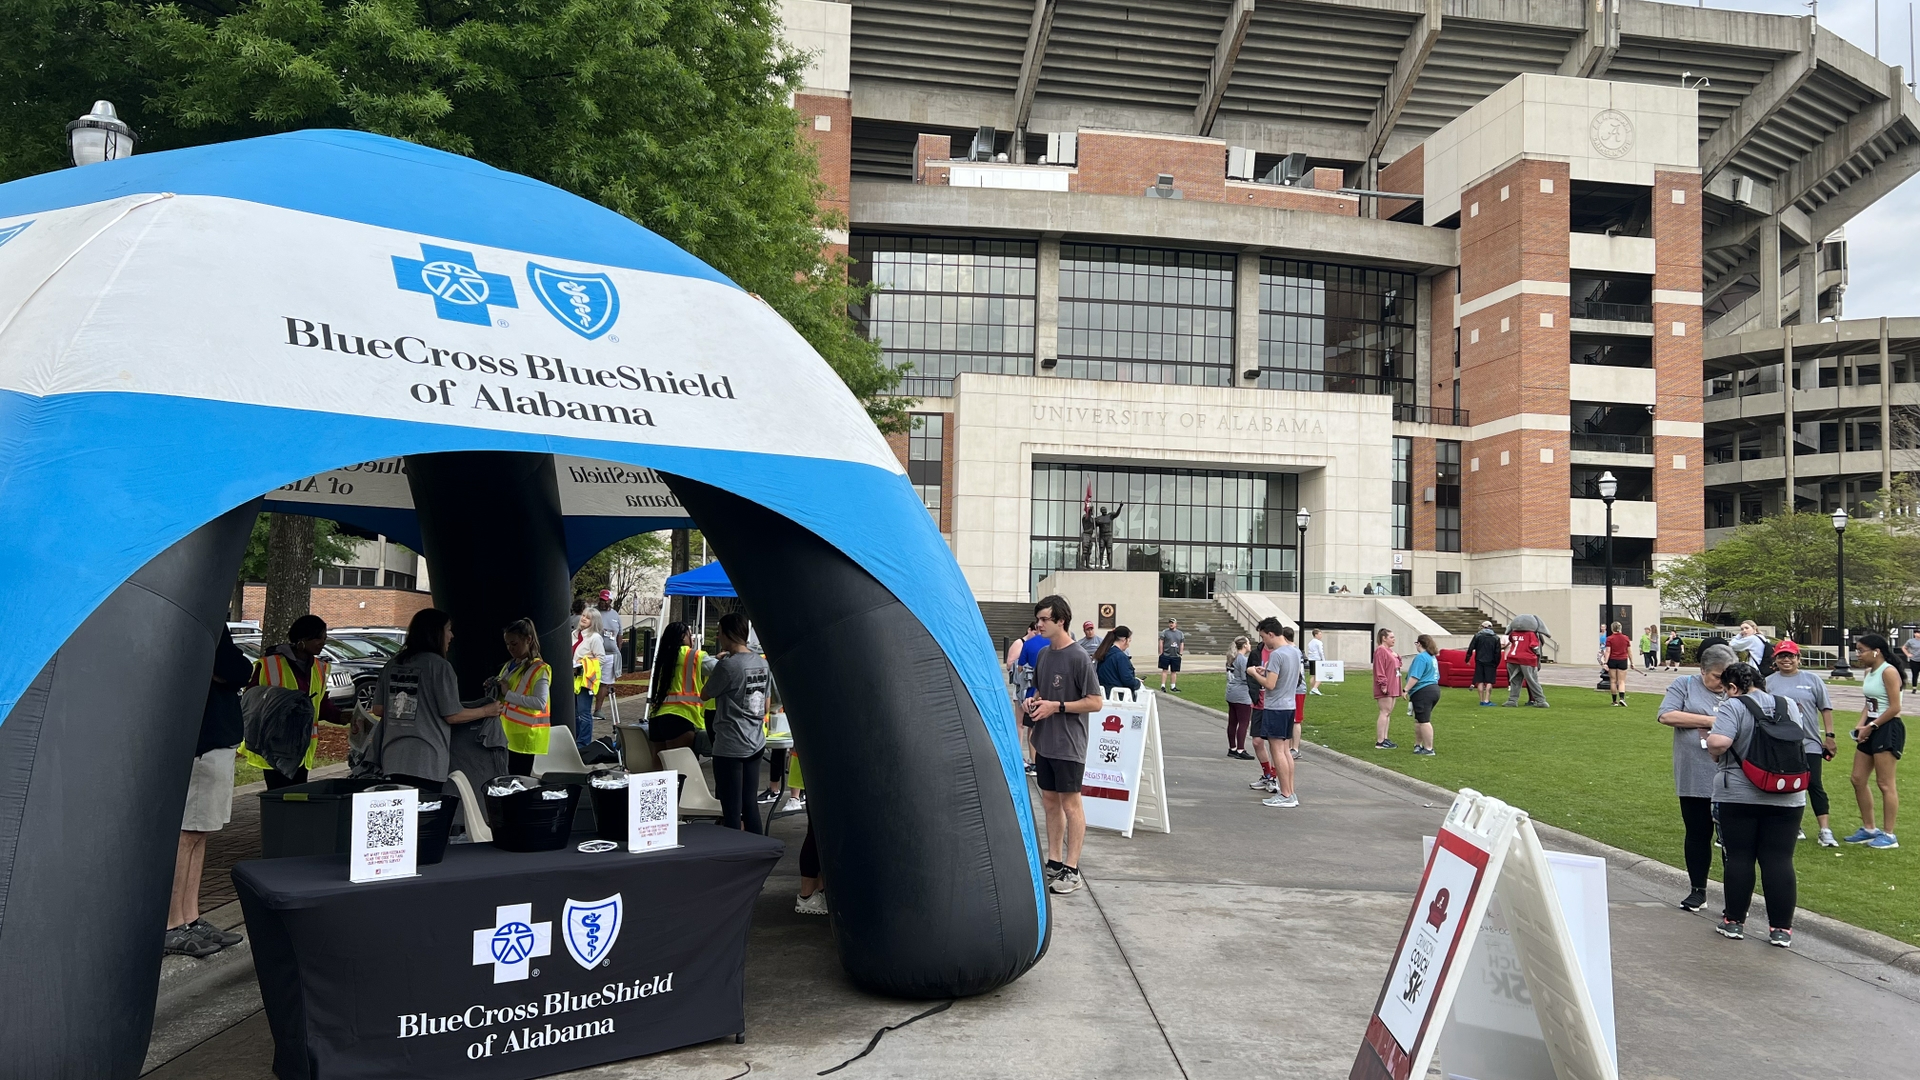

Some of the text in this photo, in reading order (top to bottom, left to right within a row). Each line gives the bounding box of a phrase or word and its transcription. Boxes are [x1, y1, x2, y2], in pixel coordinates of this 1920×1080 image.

[281, 315, 737, 400] BlueCross BlueShield
[410, 378, 658, 428] of Alabama
[1032, 404, 1324, 435] UNIVERSITY OF ALABAMA
[1098, 744, 1120, 752] COUCH
[1104, 752, 1118, 763] 5K
[1085, 771, 1124, 783] REGISTRATION
[391, 798, 403, 807] 5K
[1410, 947, 1430, 975] COUCH
[1403, 968, 1424, 1005] 5K
[396, 972, 674, 1039] BlueCross BlueShield
[466, 1016, 616, 1060] of Alabama
